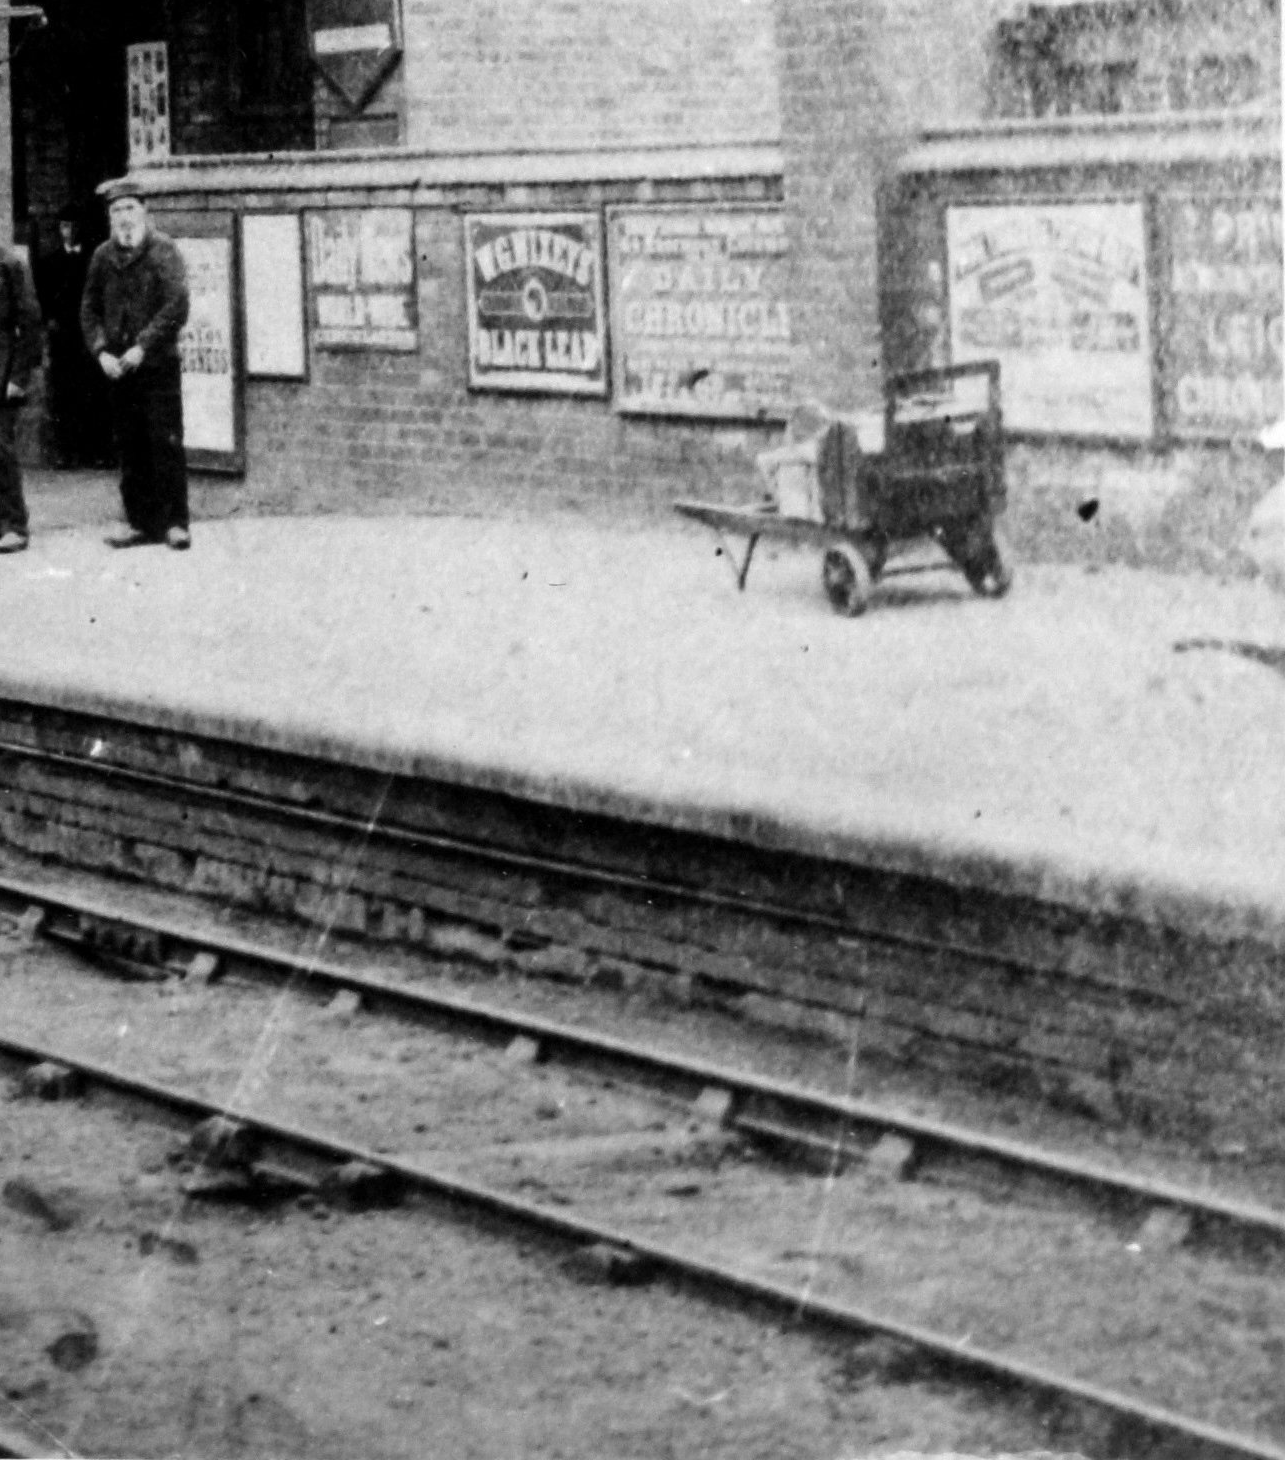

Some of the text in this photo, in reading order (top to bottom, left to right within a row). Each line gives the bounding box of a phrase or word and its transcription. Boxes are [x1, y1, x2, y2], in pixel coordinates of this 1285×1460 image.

[651, 264, 763, 292] DAILY
[478, 328, 541, 367] BLACK
[542, 329, 597, 370] LEAD
